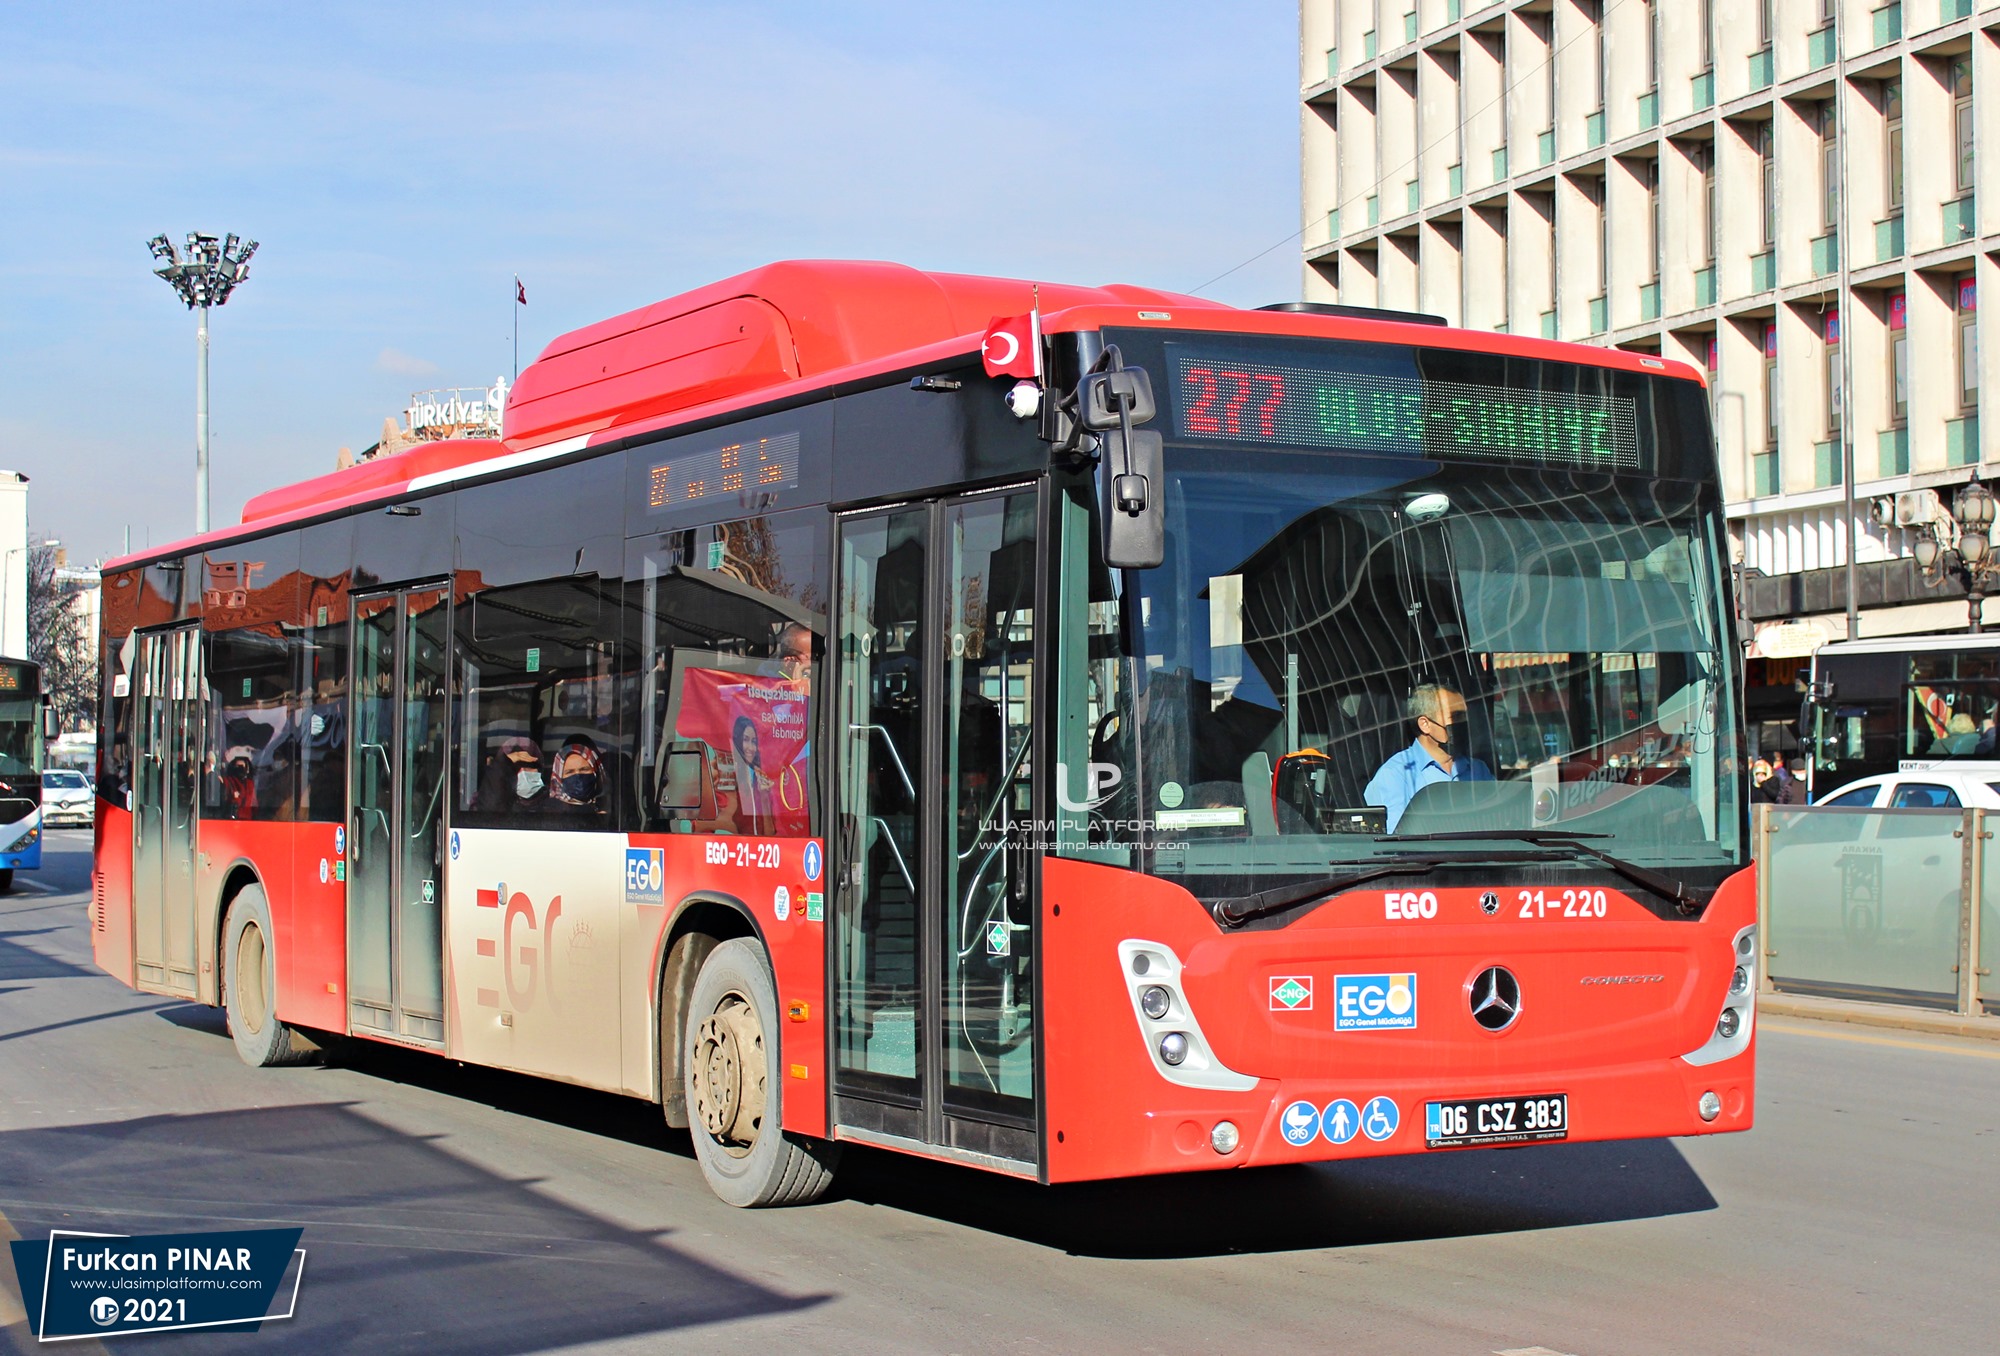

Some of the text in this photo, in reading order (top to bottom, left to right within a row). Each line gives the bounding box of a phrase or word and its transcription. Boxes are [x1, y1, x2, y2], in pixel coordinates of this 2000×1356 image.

[408, 398, 484, 429] TÜRKİYE
[1186, 368, 1284, 436] 277
[705, 841, 780, 869] EGO-21-220
[627, 858, 662, 891] EGO
[1385, 890, 1607, 919] EGO 21-220
[1278, 988, 1304, 999] CNG
[1580, 974, 1664, 985] CONECTO
[1339, 984, 1412, 1017] EGO
[1339, 1016, 1412, 1027] EGO Genel Müdürlüğü
[1430, 1099, 1562, 1135] TR 06 CSZ 383
